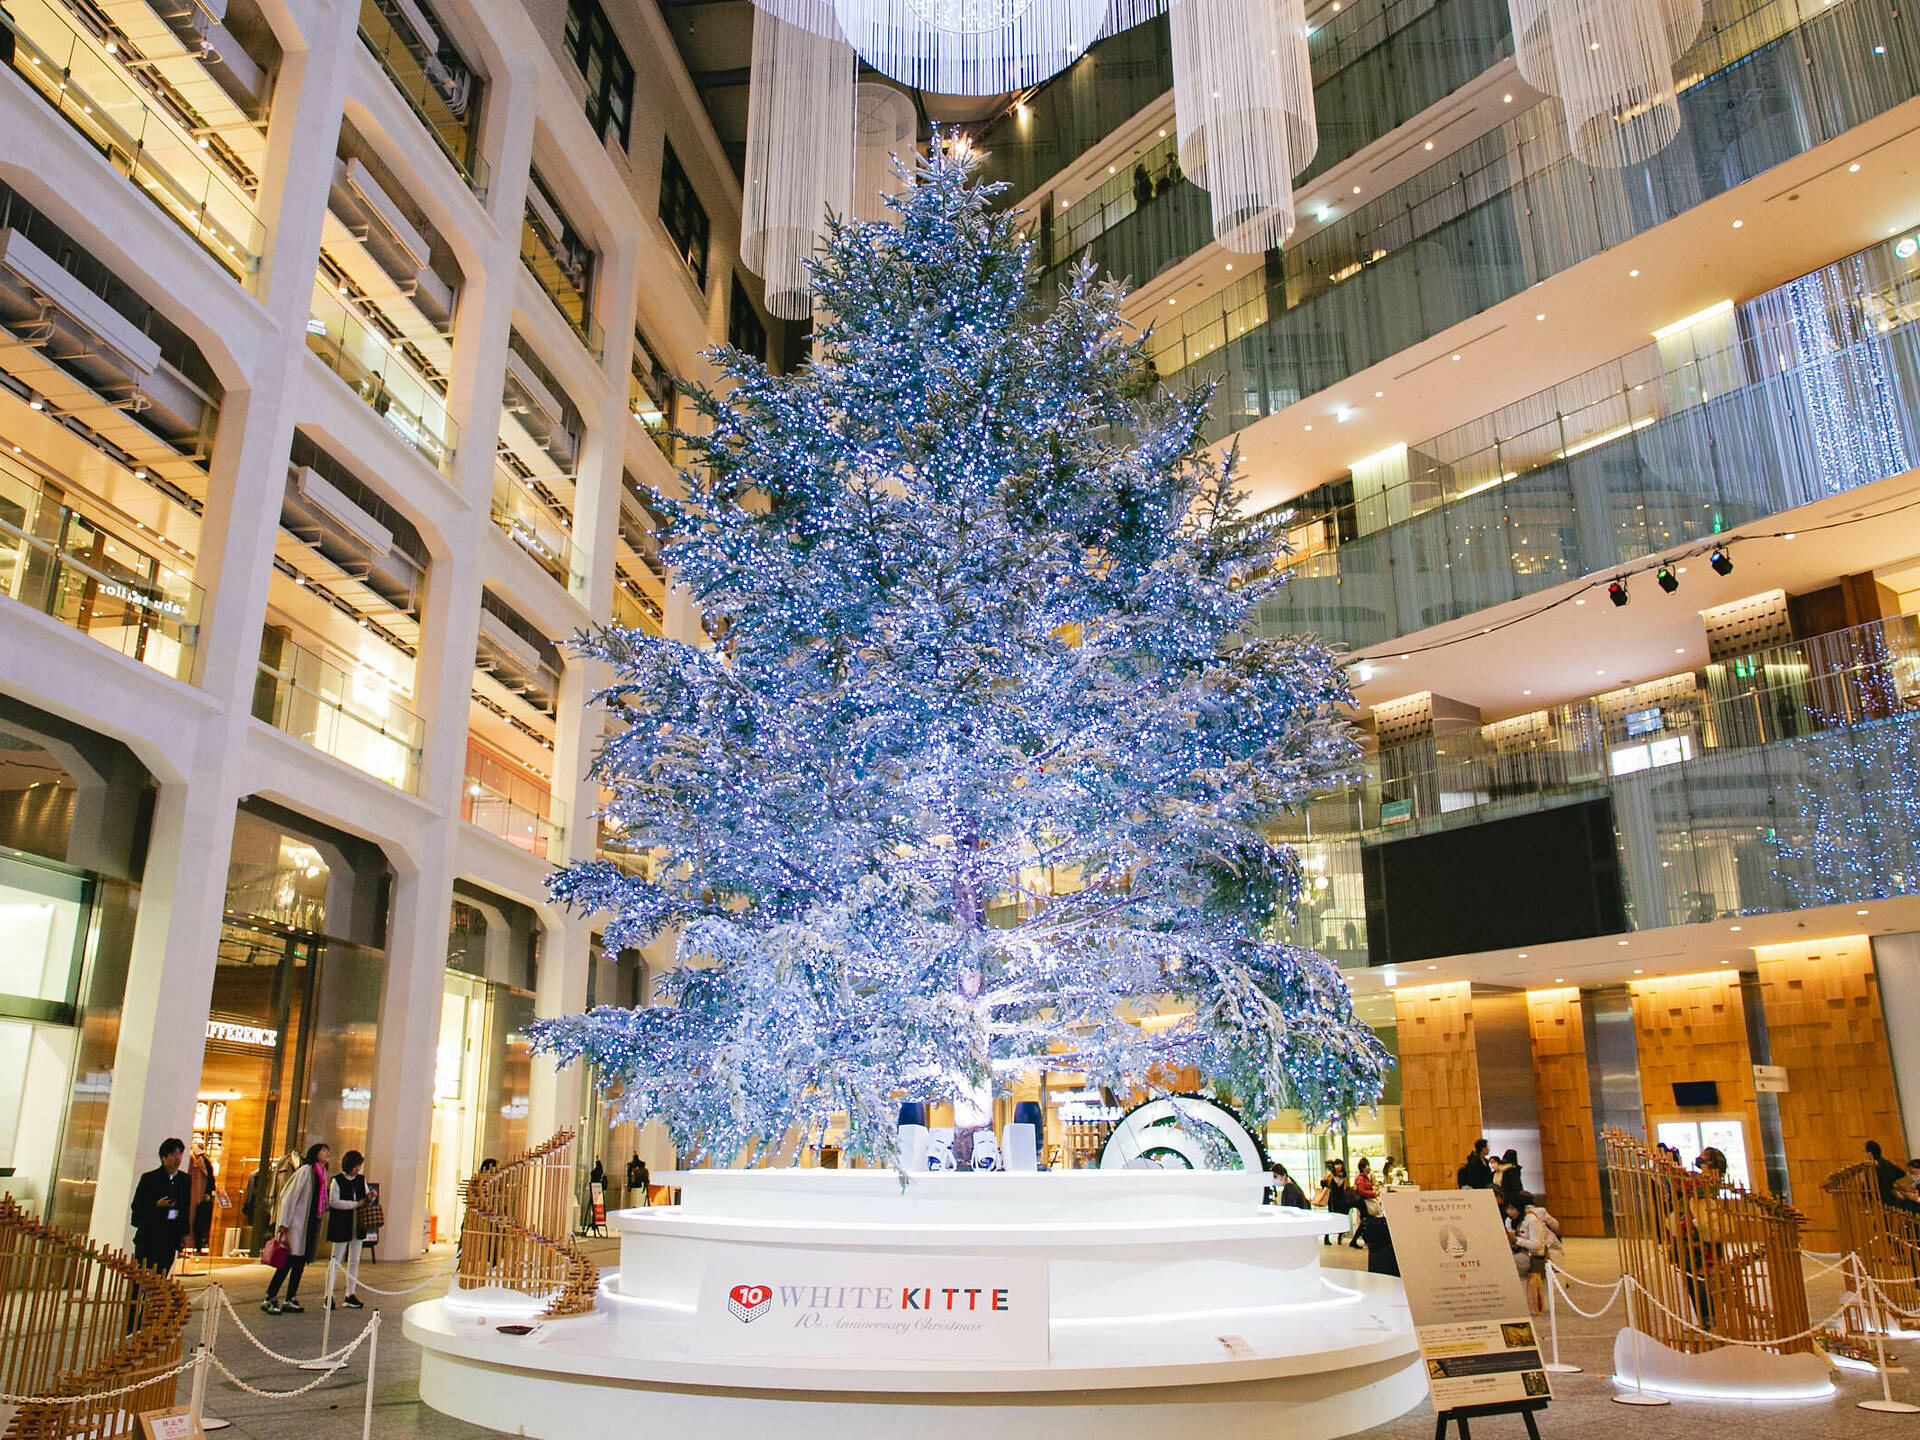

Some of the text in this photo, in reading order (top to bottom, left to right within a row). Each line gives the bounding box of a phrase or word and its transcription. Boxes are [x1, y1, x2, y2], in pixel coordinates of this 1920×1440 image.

[206, 1021, 277, 1047] IFFERENCE
[779, 1285, 1009, 1311] WHITE KITTE
[825, 1316, 912, 1334] Anniversary
[914, 1316, 983, 1332] Christmas
